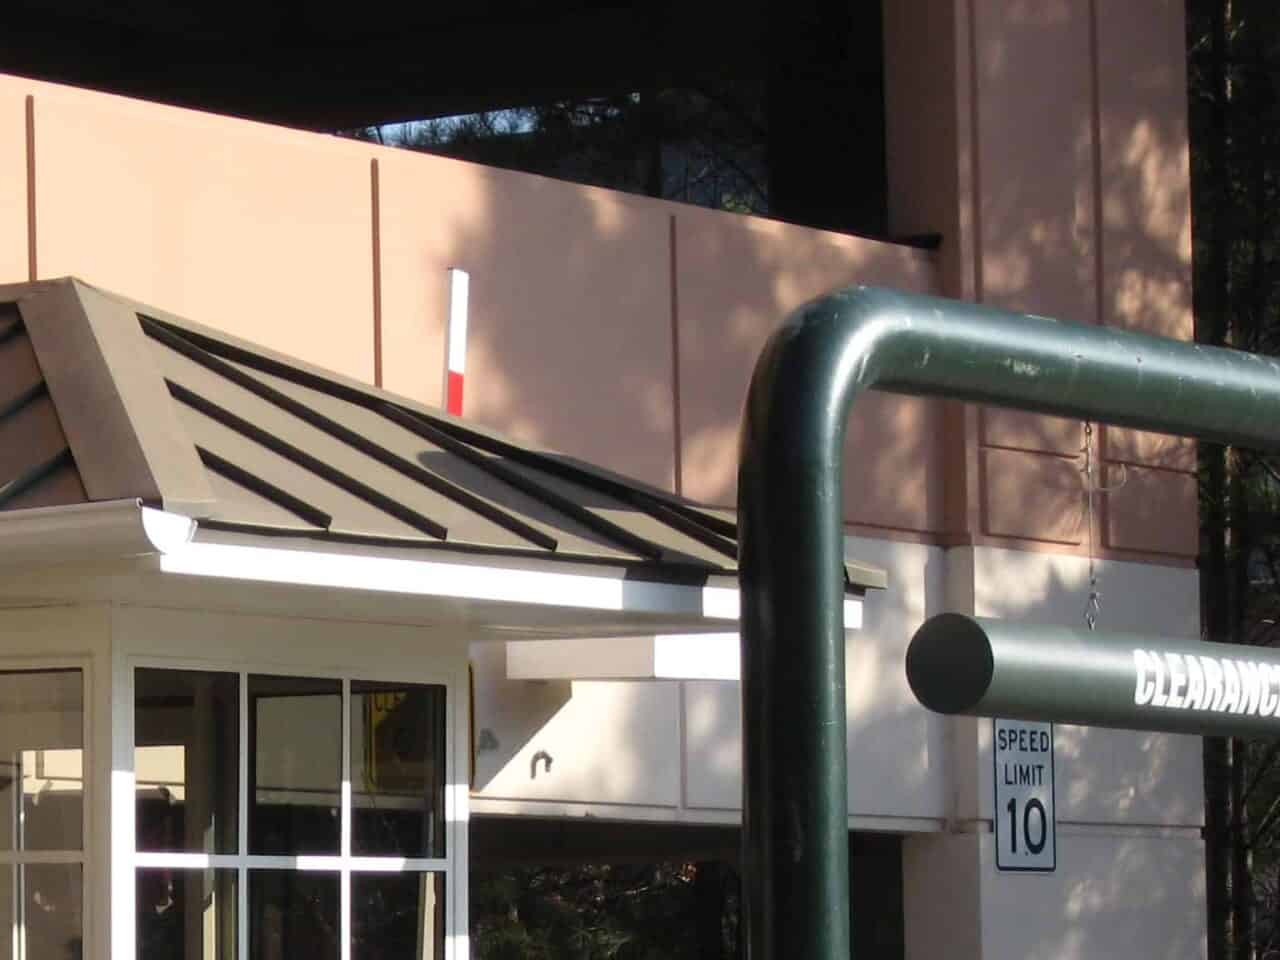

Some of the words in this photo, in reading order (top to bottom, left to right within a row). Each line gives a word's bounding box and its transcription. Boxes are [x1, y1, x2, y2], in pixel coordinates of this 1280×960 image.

[998, 728, 1049, 753] SPEED
[1004, 763, 1045, 786] LIMIT
[1006, 797, 1048, 856] 10
